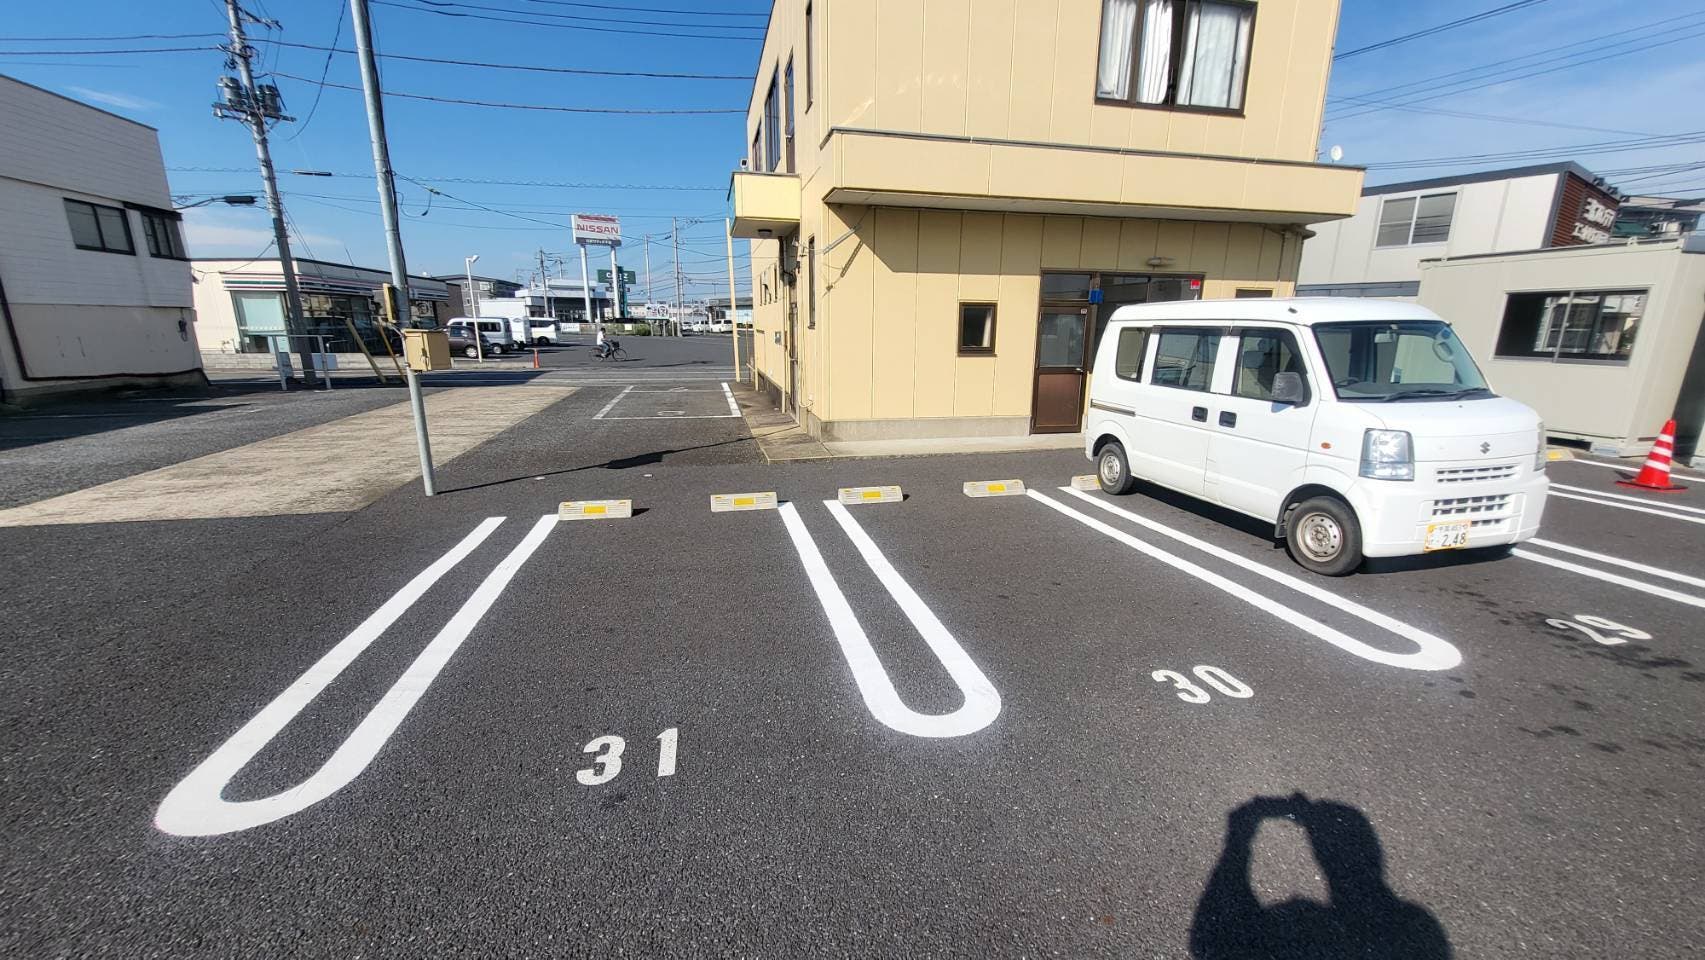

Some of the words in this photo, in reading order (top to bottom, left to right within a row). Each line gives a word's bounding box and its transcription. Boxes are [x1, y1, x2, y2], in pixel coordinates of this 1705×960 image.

[577, 223, 619, 234] NISSAN
[1545, 614, 1653, 645] 29
[1151, 665, 1254, 704] 30
[576, 727, 678, 785] 31
